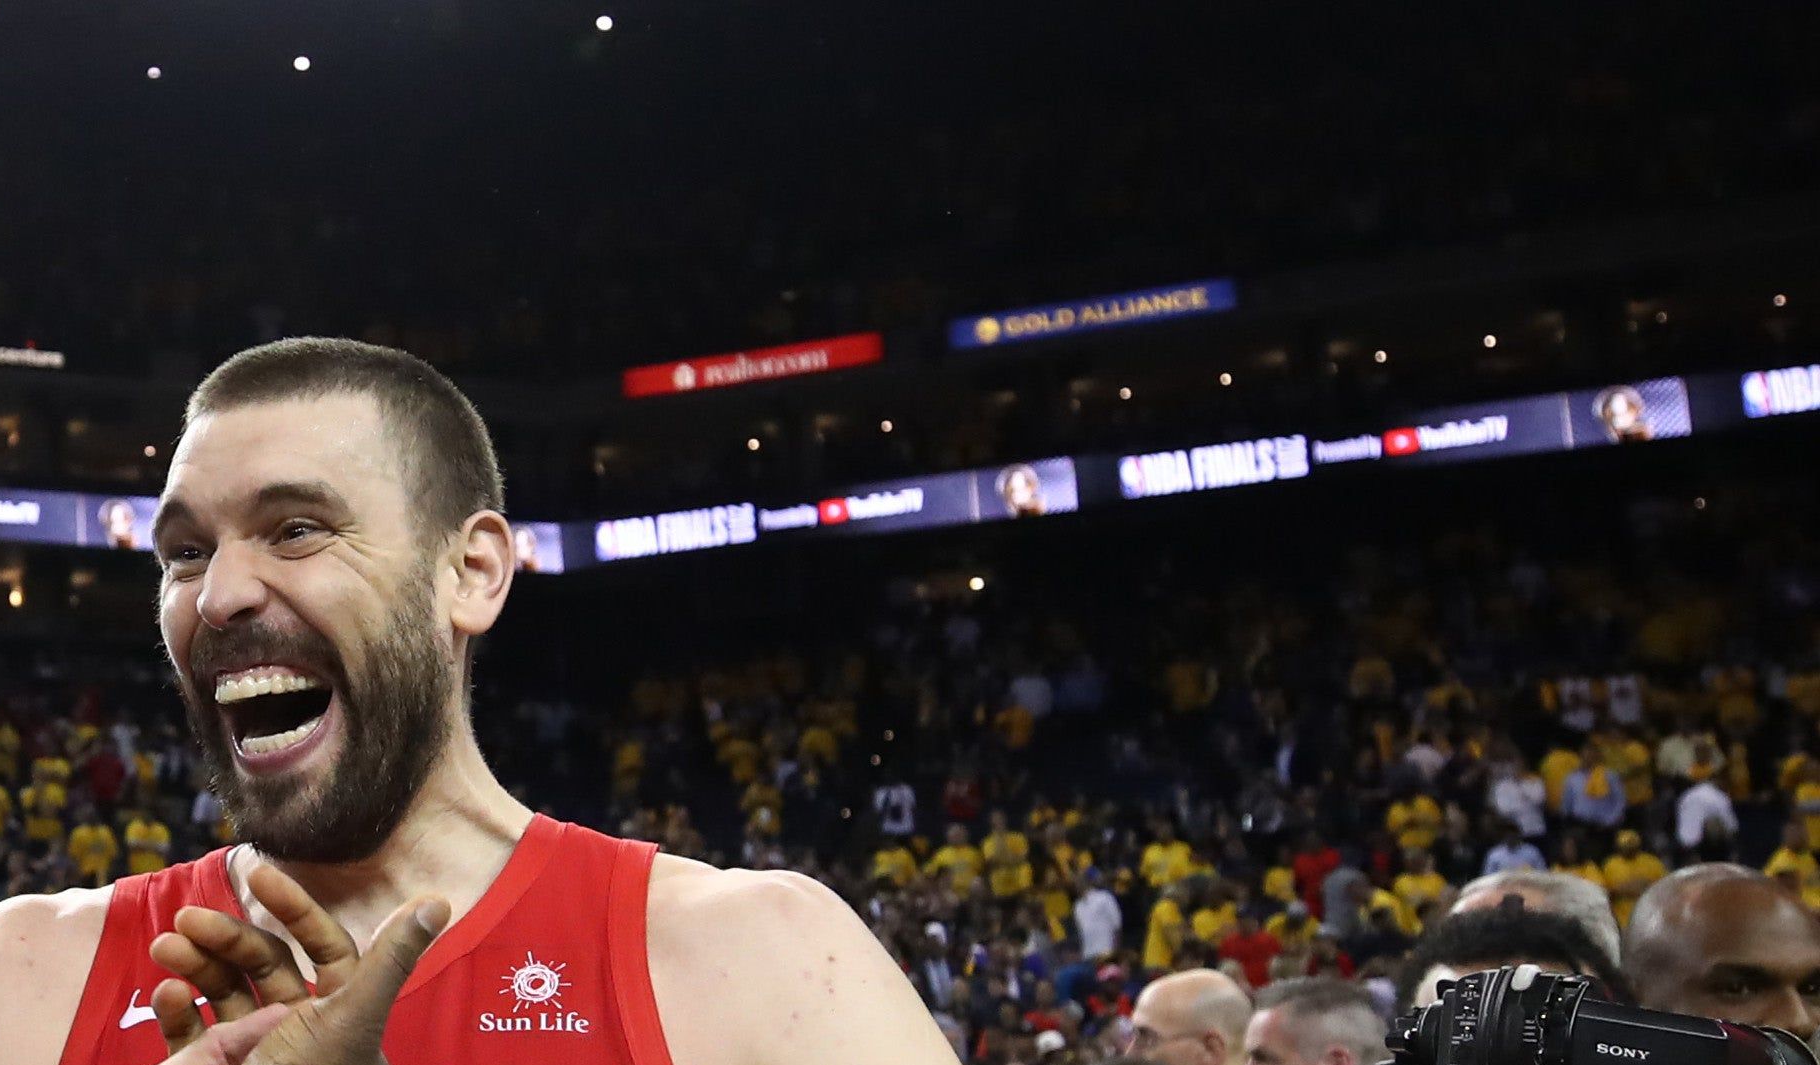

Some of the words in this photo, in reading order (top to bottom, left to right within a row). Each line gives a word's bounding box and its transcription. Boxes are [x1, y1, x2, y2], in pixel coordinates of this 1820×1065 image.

[1003, 307, 1076, 337] GOLD
[1080, 286, 1207, 325] ALLIANCE
[1140, 450, 1193, 498] NBA
[1190, 438, 1276, 492] FINALS
[612, 516, 658, 559] NBA
[656, 506, 729, 554] FINALS
[479, 1012, 532, 1032] Sun
[539, 1011, 590, 1033] Life
[1596, 1042, 1651, 1060] SONY
